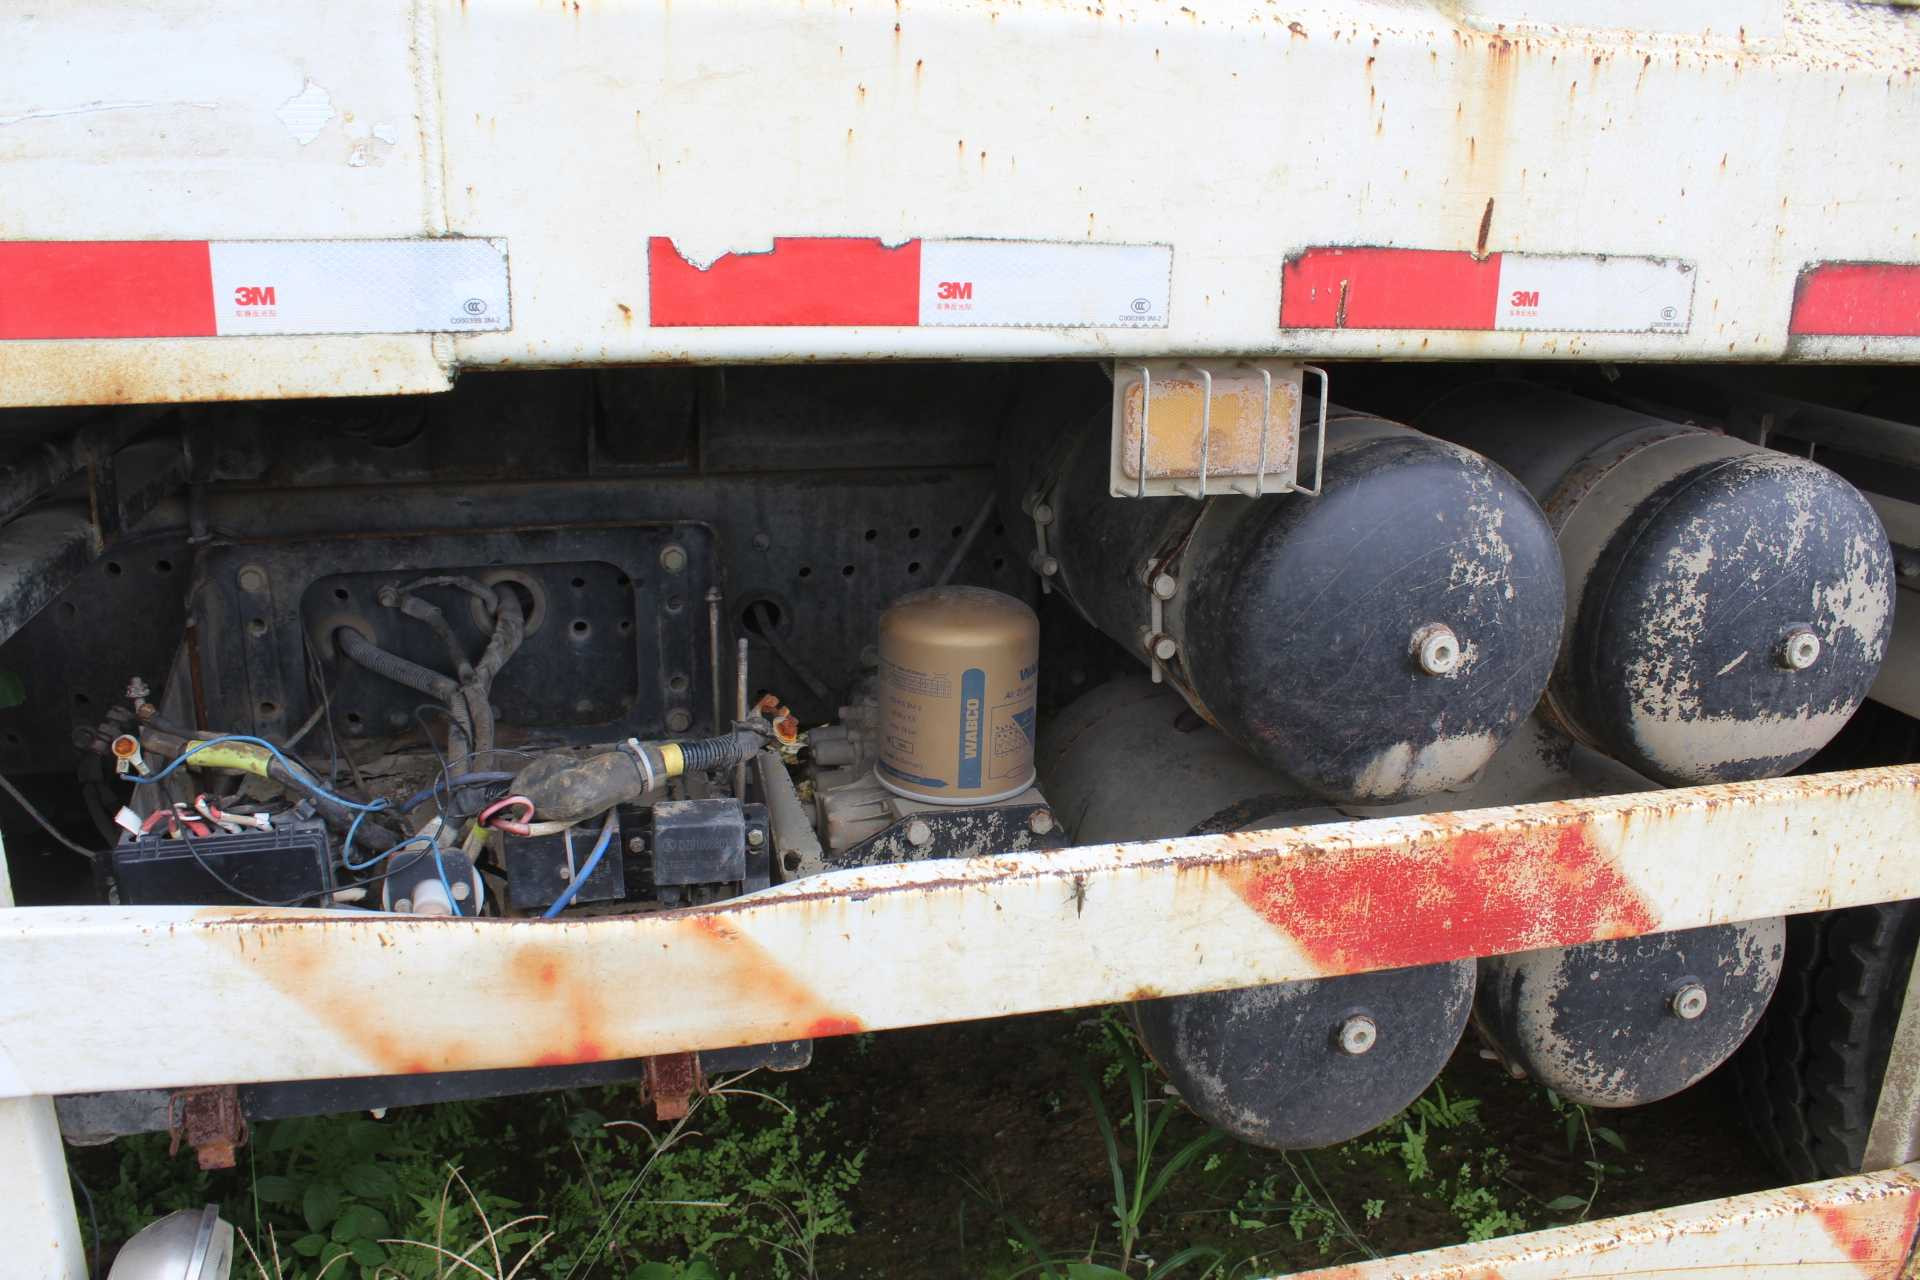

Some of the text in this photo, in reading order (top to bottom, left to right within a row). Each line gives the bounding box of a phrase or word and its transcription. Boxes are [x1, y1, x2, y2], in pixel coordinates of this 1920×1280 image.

[235, 287, 275, 305] 3M
[937, 282, 972, 300] 3M
[1511, 291, 1540, 307] 3M
[964, 698, 980, 759] WABCO
